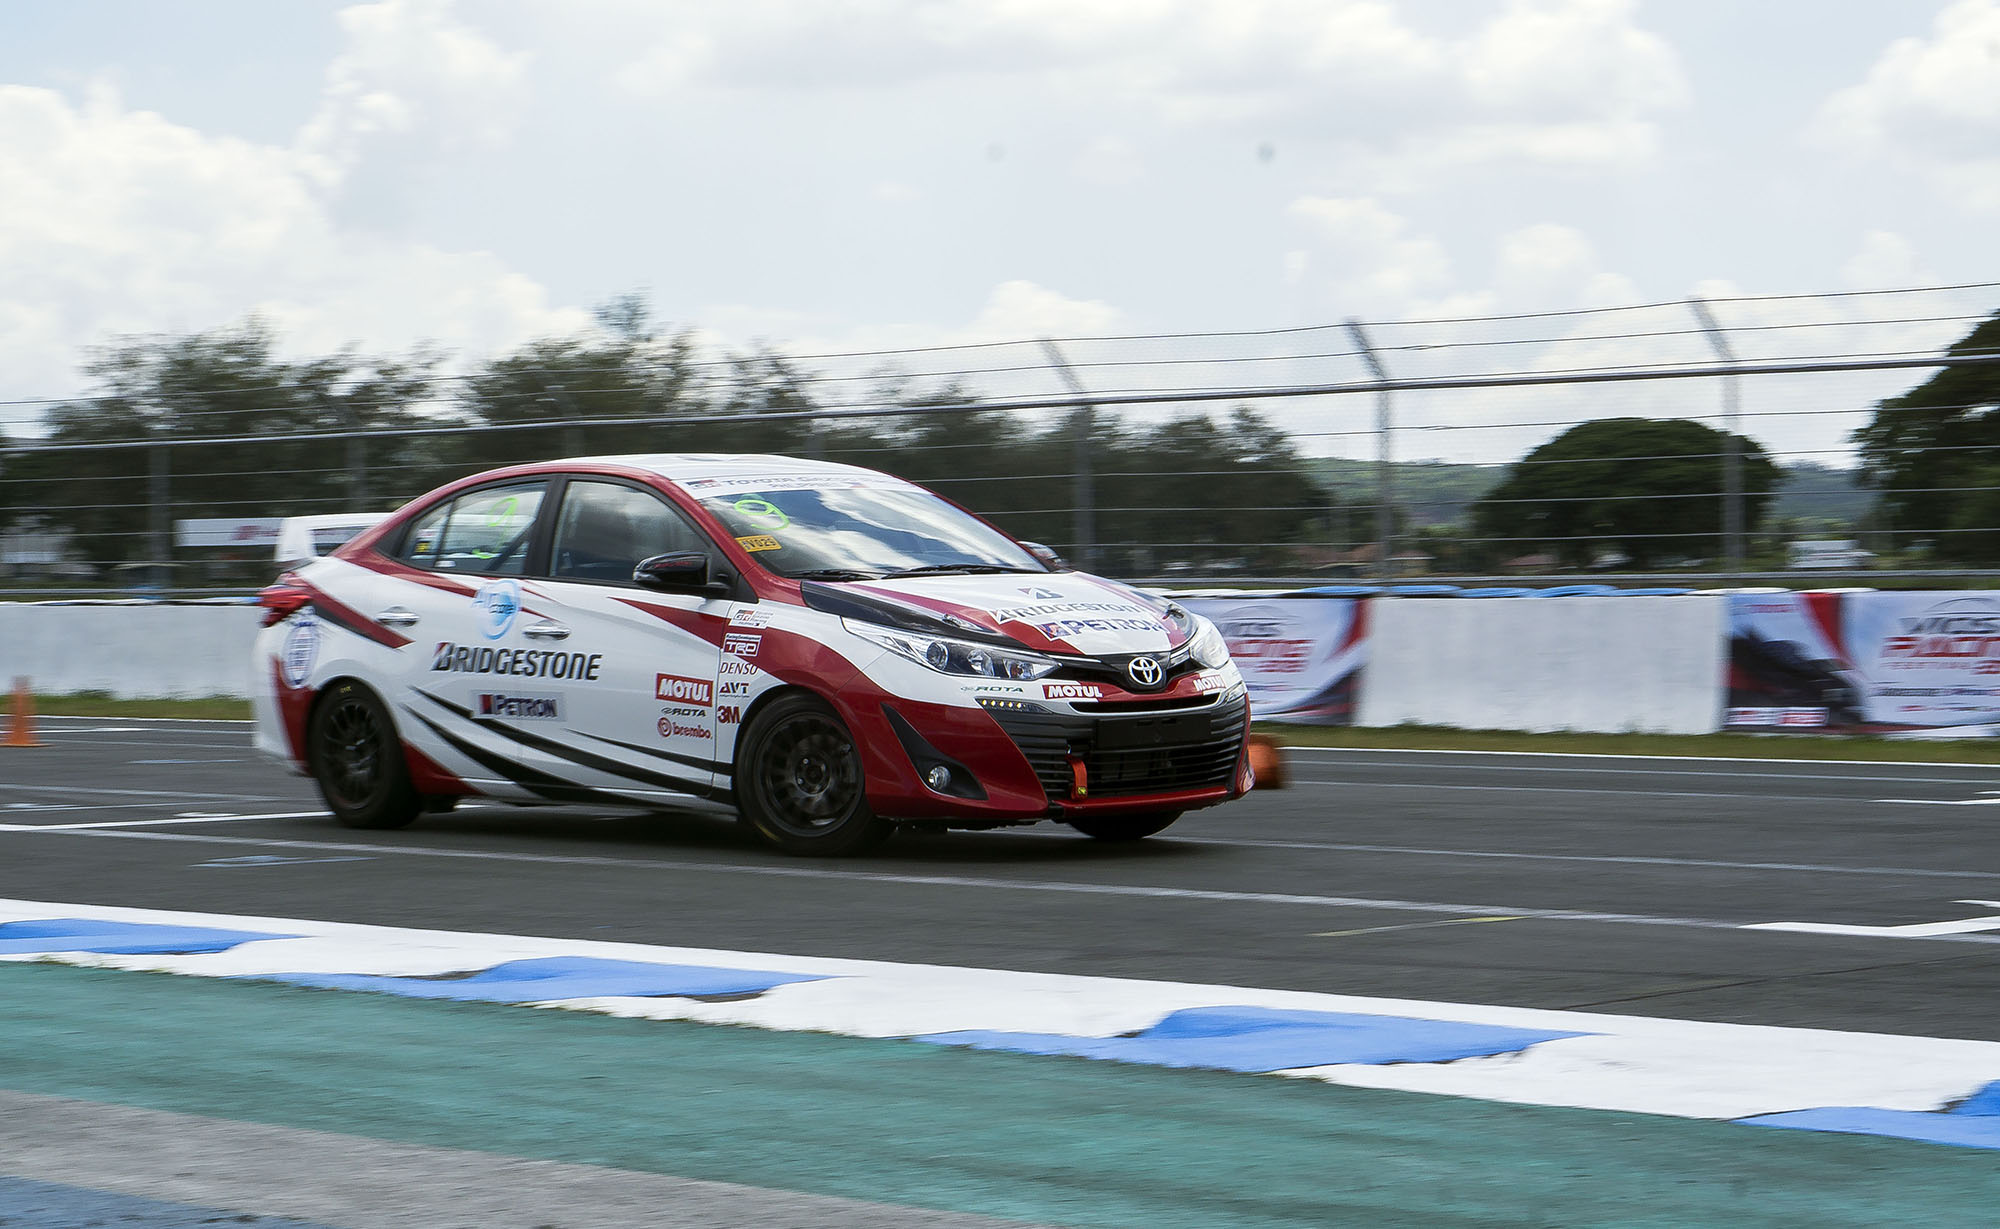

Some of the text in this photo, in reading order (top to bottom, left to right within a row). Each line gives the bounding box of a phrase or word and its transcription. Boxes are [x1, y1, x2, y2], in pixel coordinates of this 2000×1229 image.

[734, 499, 790, 530] 9
[726, 641, 757, 654] TRD
[430, 642, 603, 681] BRIDGESTONE
[720, 662, 759, 675] DENSO
[658, 678, 711, 702] MOTUL
[719, 682, 750, 694] AVT
[1048, 685, 1103, 698] MOTUL
[494, 694, 558, 718] PETRON
[671, 707, 707, 717] ROTA
[718, 705, 741, 724] 3M
